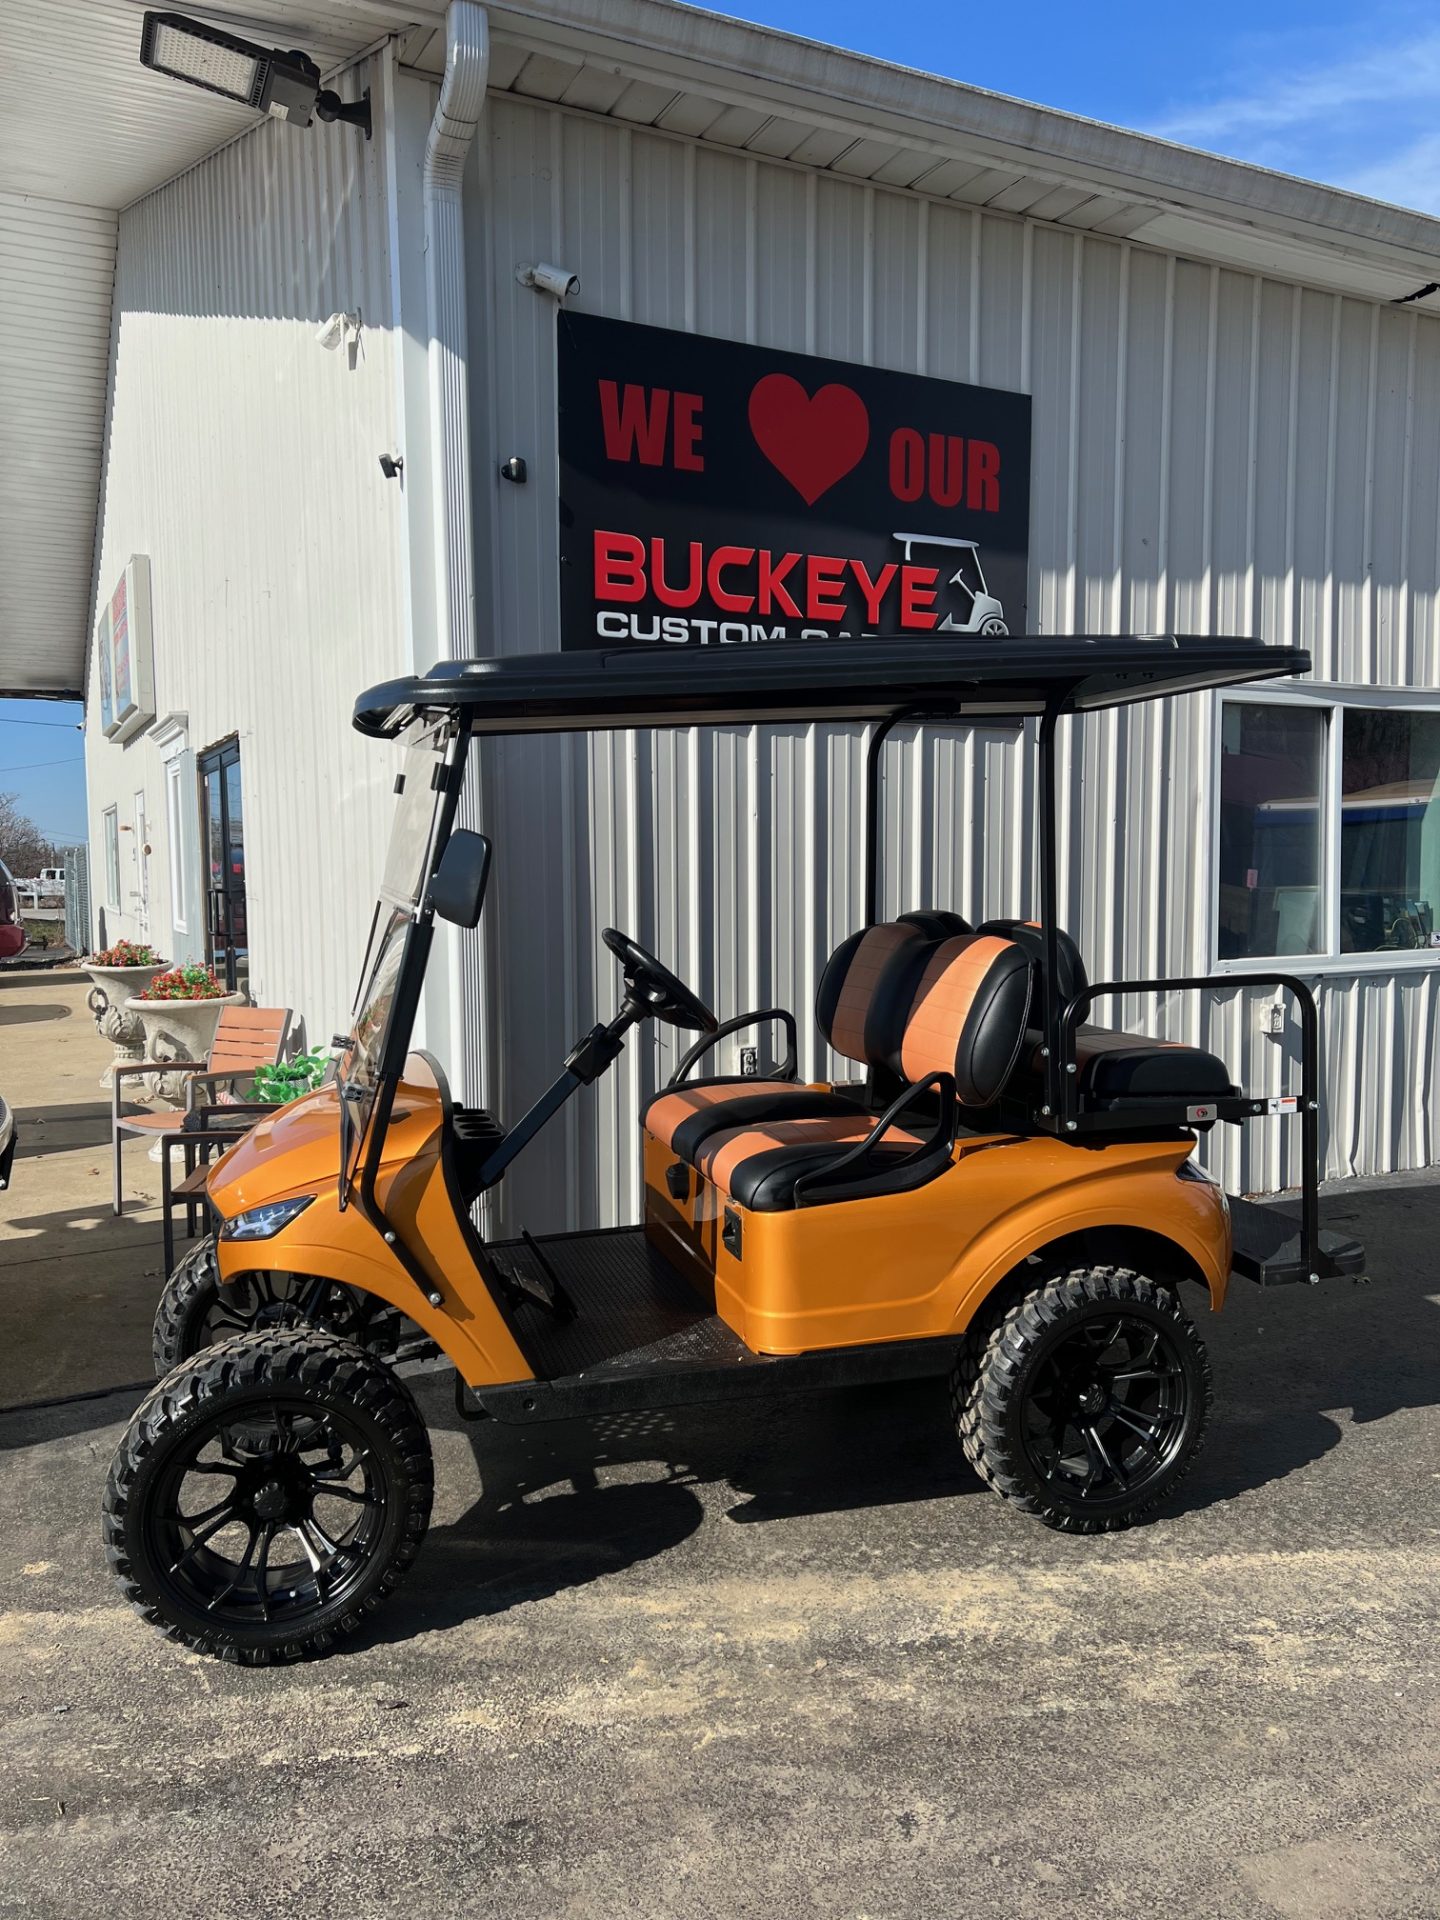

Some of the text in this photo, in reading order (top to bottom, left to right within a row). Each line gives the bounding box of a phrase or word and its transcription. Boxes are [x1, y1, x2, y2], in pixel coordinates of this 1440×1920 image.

[598, 379, 1001, 513] WE OUR
[593, 529, 940, 630] BUCKEYE
